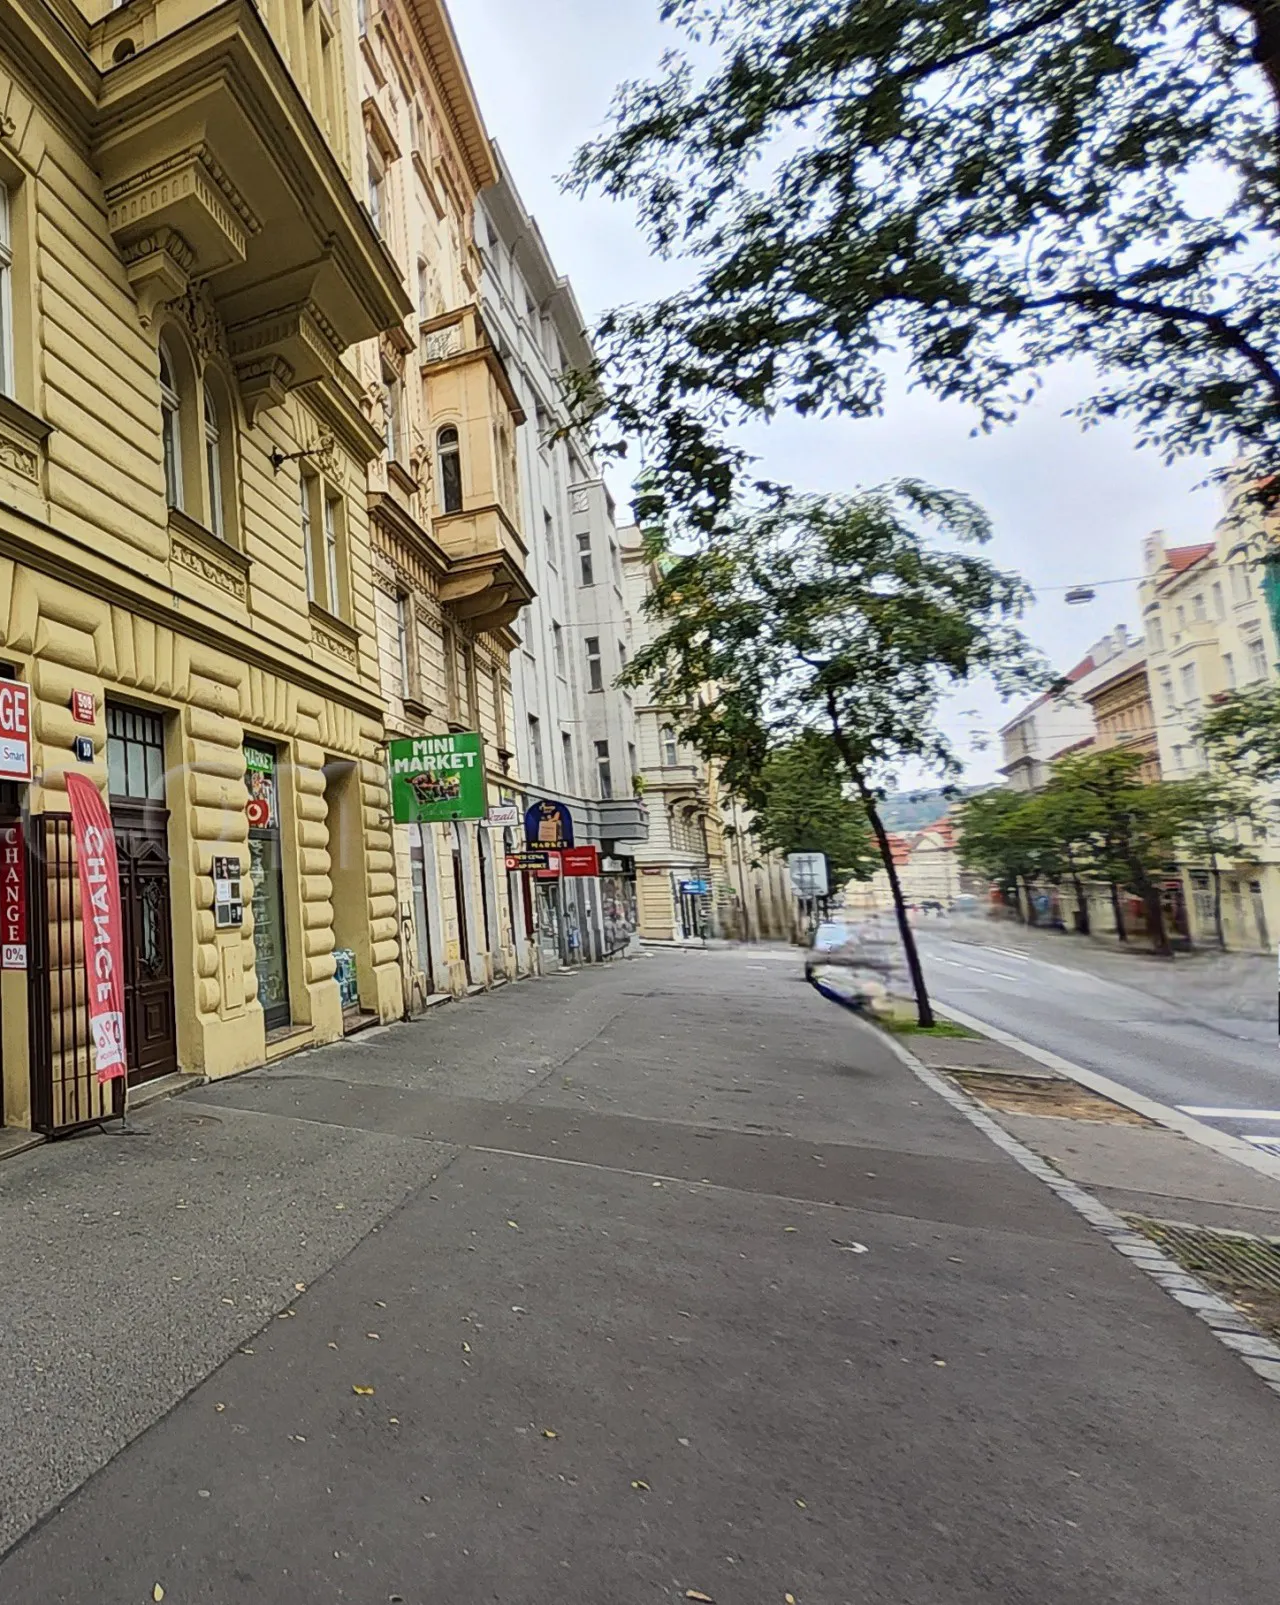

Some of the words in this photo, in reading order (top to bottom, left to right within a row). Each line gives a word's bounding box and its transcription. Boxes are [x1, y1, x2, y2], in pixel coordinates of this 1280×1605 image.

[3, 747, 25, 762] Smart
[413, 738, 455, 756] MINI
[394, 752, 477, 774] MARKET
[5, 828, 20, 942] CHANGE
[6, 948, 24, 960] 0%
